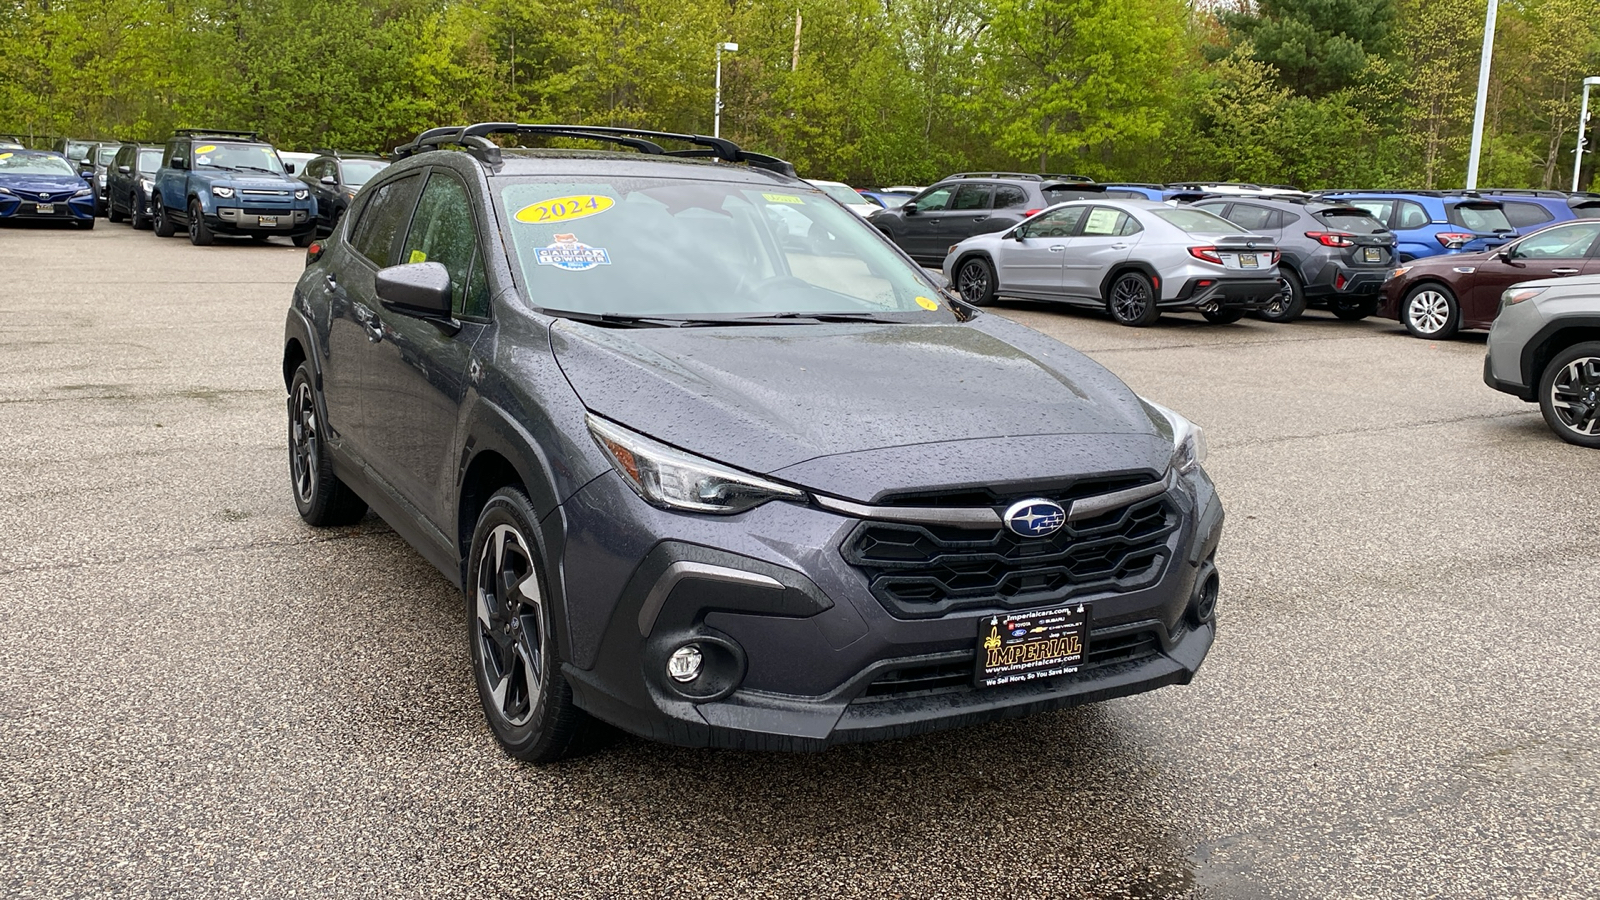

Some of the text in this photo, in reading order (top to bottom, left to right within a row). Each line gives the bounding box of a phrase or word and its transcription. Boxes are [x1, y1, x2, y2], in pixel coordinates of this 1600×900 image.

[535, 196, 599, 221] 2024
[538, 249, 603, 257] CARFAX
[1006, 607, 1070, 620] Imperialcars.com
[1048, 622, 1083, 630] CHEVROLET
[986, 636, 1082, 668] IMPERIAL
[985, 654, 1081, 674] www.imperialcars.com
[997, 677, 1009, 685] Sell
[1009, 674, 1026, 683] More,
[1036, 670, 1048, 678] You
[1048, 668, 1063, 676] Save
[1063, 666, 1078, 674] More
